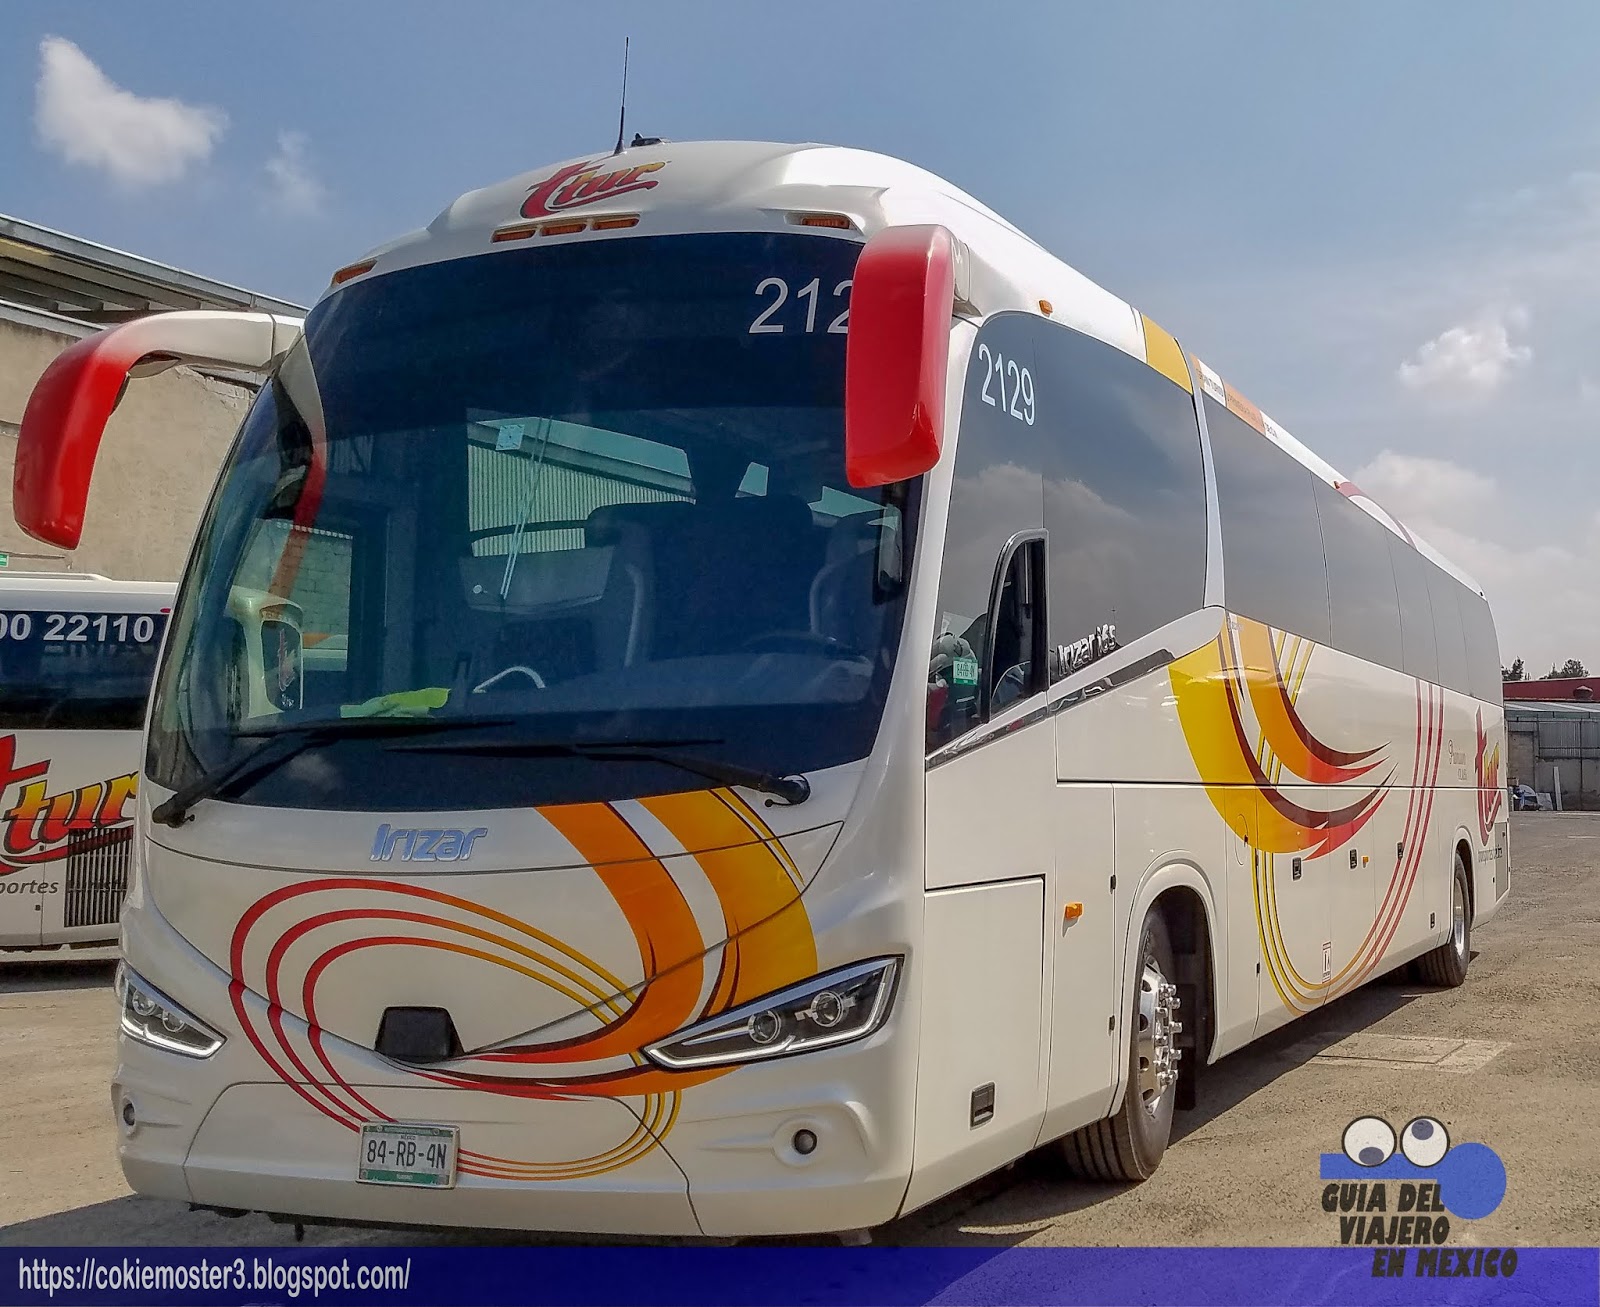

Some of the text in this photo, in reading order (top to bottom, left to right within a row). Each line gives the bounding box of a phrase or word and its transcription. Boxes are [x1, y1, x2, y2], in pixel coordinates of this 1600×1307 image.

[978, 343, 1036, 426] 2129
[43, 614, 155, 643] 22110
[369, 823, 488, 862] Irizar
[367, 1140, 447, 1169] 84-RB-4N
